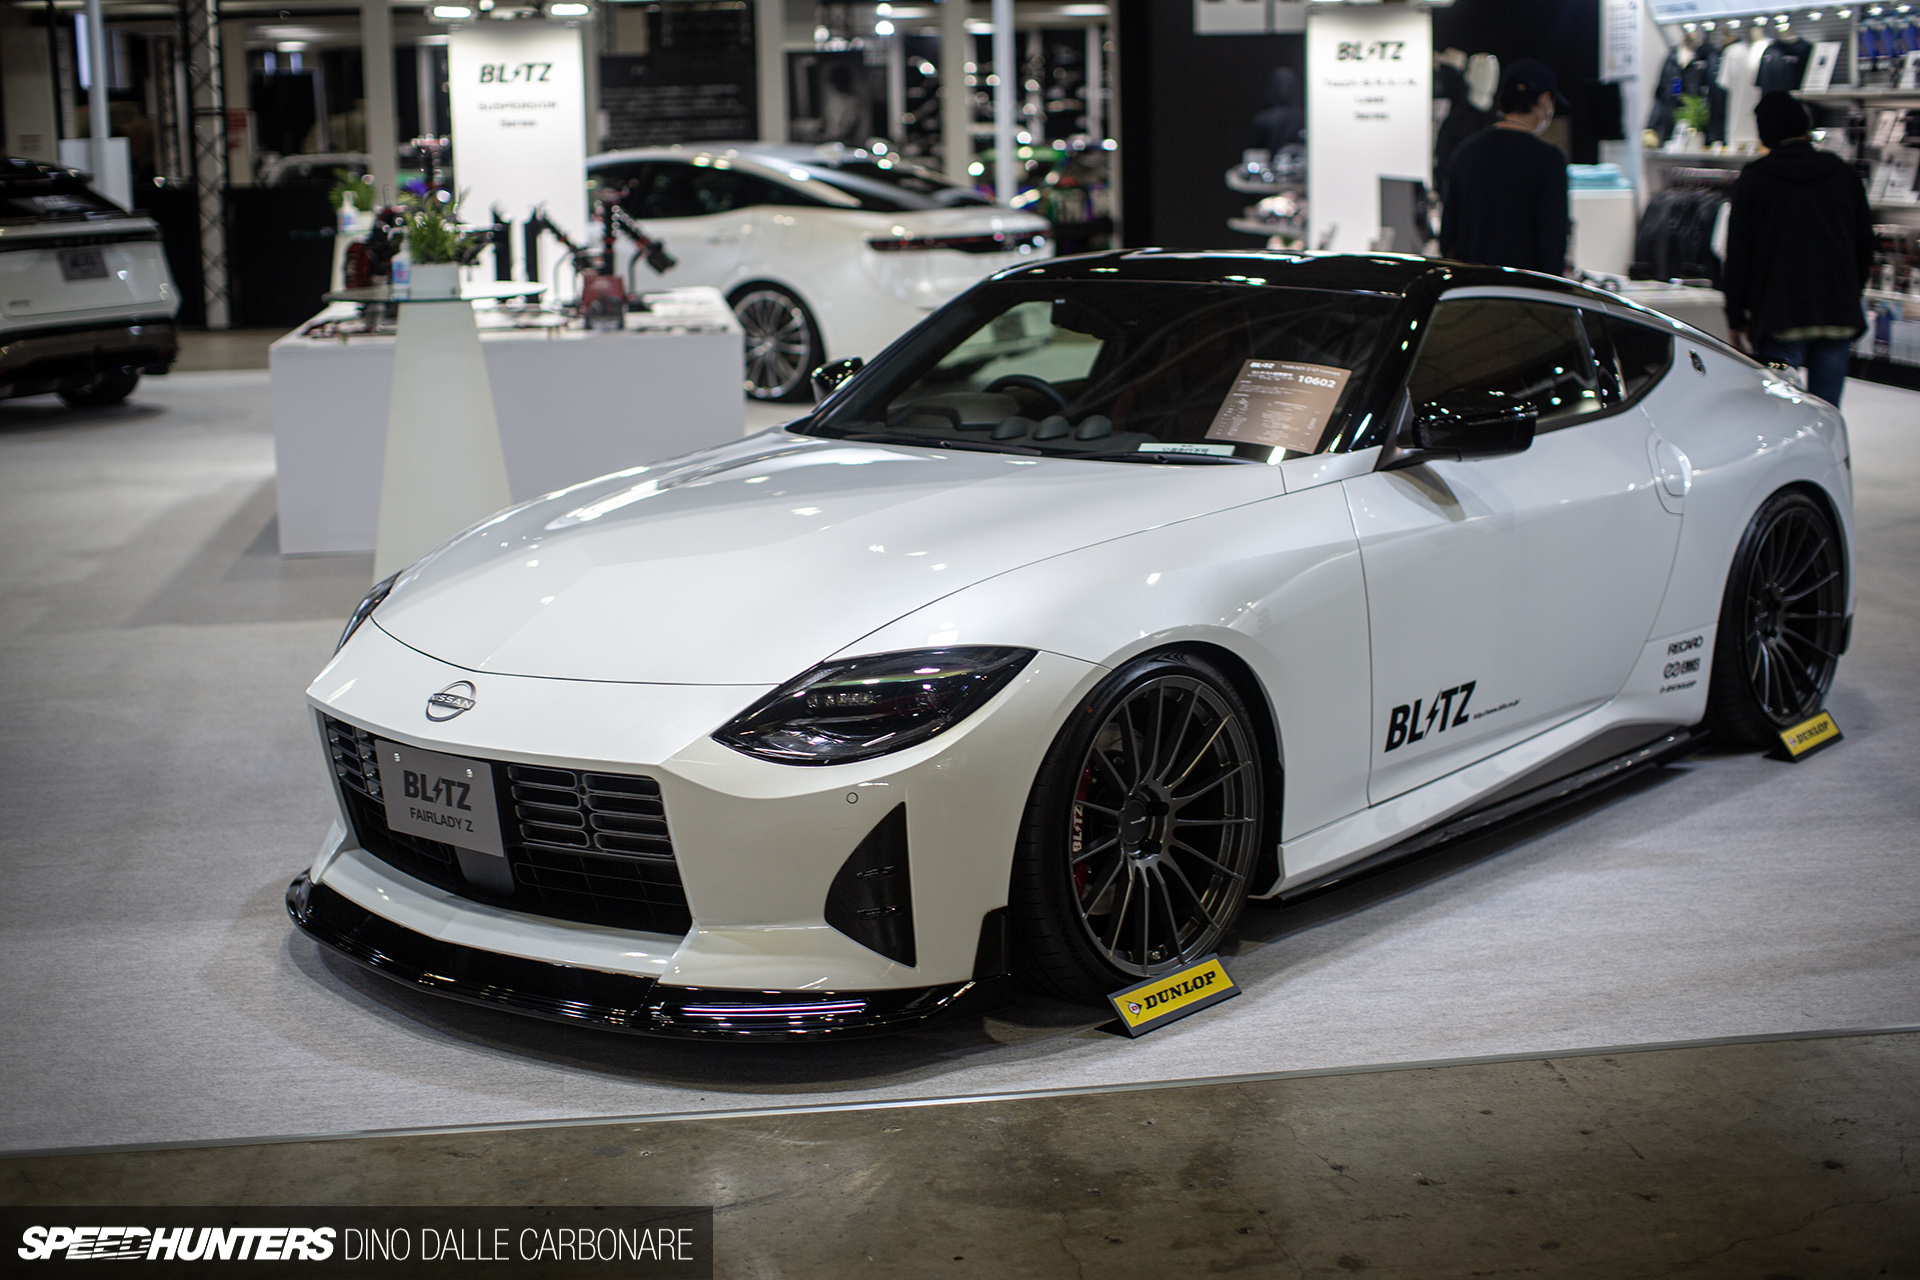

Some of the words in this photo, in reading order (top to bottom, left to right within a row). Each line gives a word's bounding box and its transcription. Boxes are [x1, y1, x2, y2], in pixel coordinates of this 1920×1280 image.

[479, 62, 552, 83] BLITZ
[1298, 375, 1336, 389] 10602
[1667, 635, 1704, 656] RECARO
[430, 693, 473, 710] NISSAN
[1384, 680, 1477, 753] BLITZ
[1796, 720, 1829, 745] DUNLOP
[403, 769, 472, 811] BLITZ
[410, 807, 462, 830] FAIRLADY
[465, 819, 474, 832] Z
[1072, 804, 1084, 852] BLITZ
[1144, 971, 1216, 1010] DUNLOP
